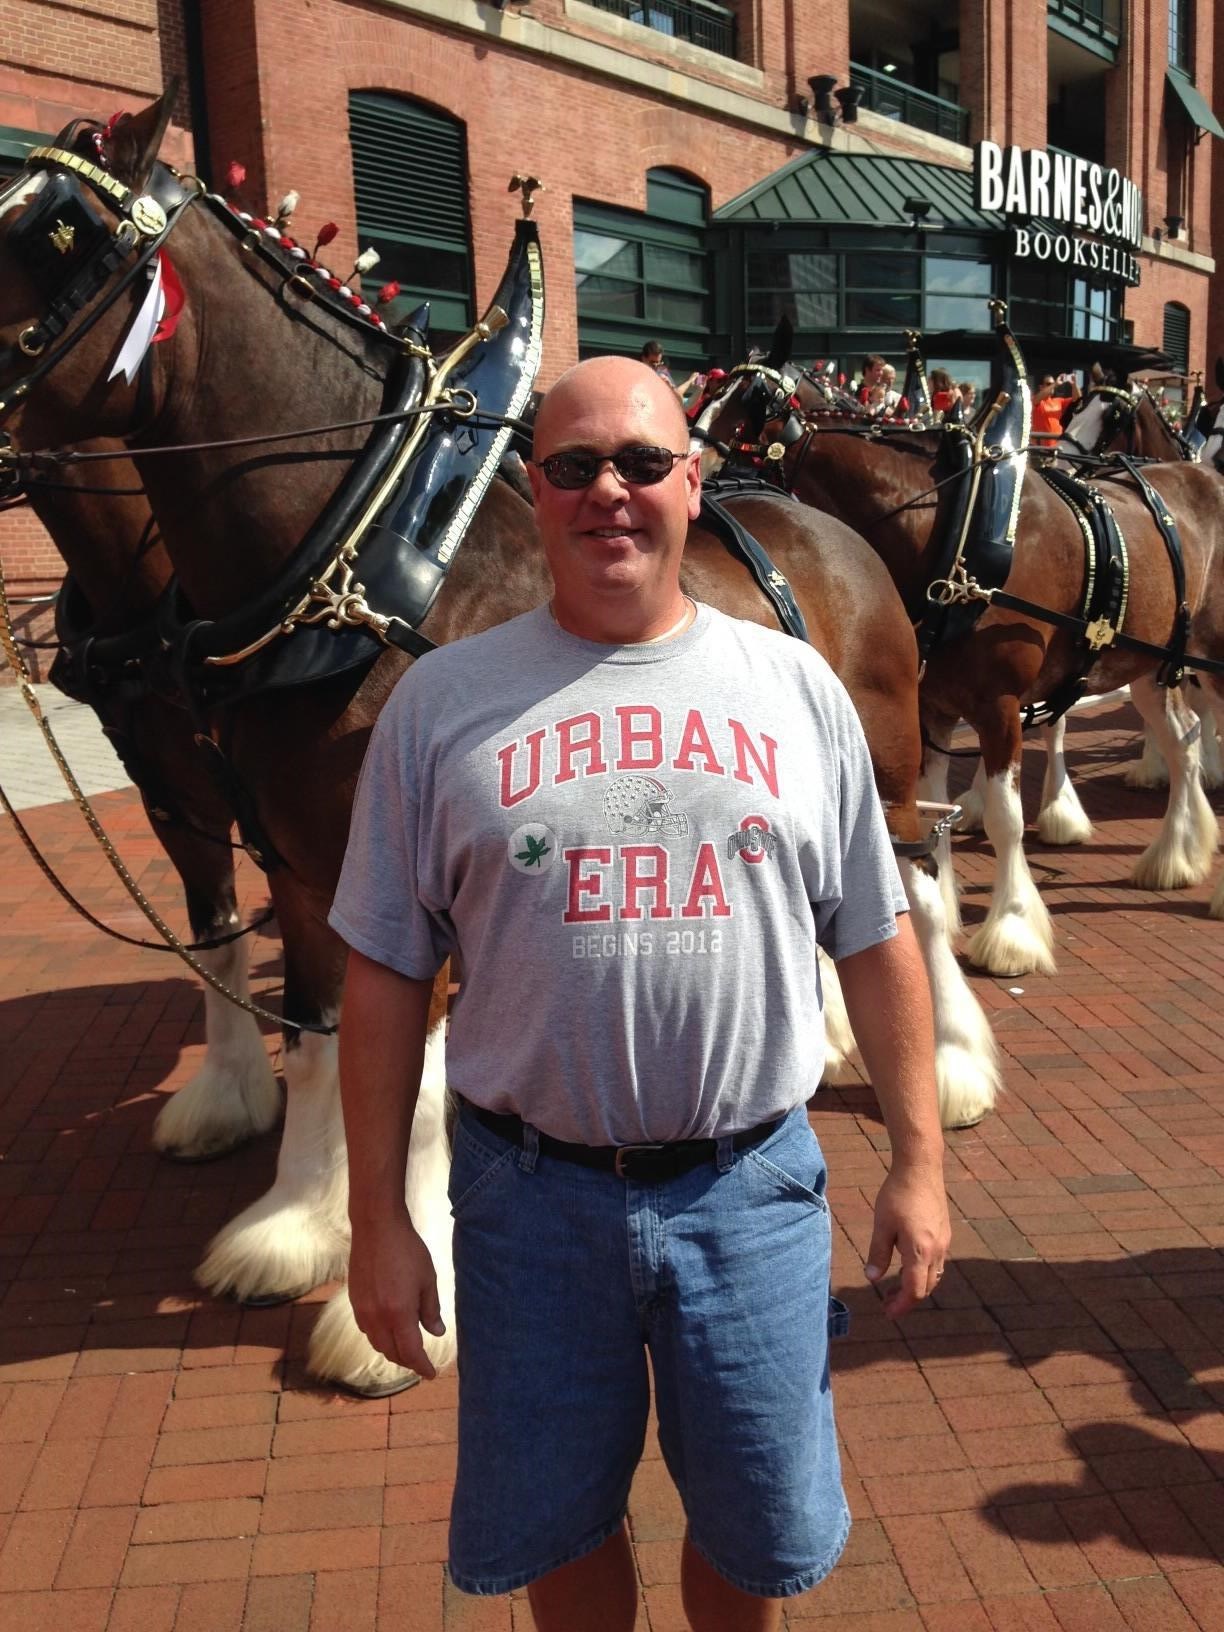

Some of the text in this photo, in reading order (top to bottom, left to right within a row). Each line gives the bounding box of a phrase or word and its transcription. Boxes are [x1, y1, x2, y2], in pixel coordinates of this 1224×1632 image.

[980, 140, 1103, 230] BARNES
[1014, 229, 1139, 283] BOOKSELLE
[496, 705, 780, 809] URBAN
[562, 841, 733, 924] ERA
[572, 929, 724, 959] BEGINS 2012
